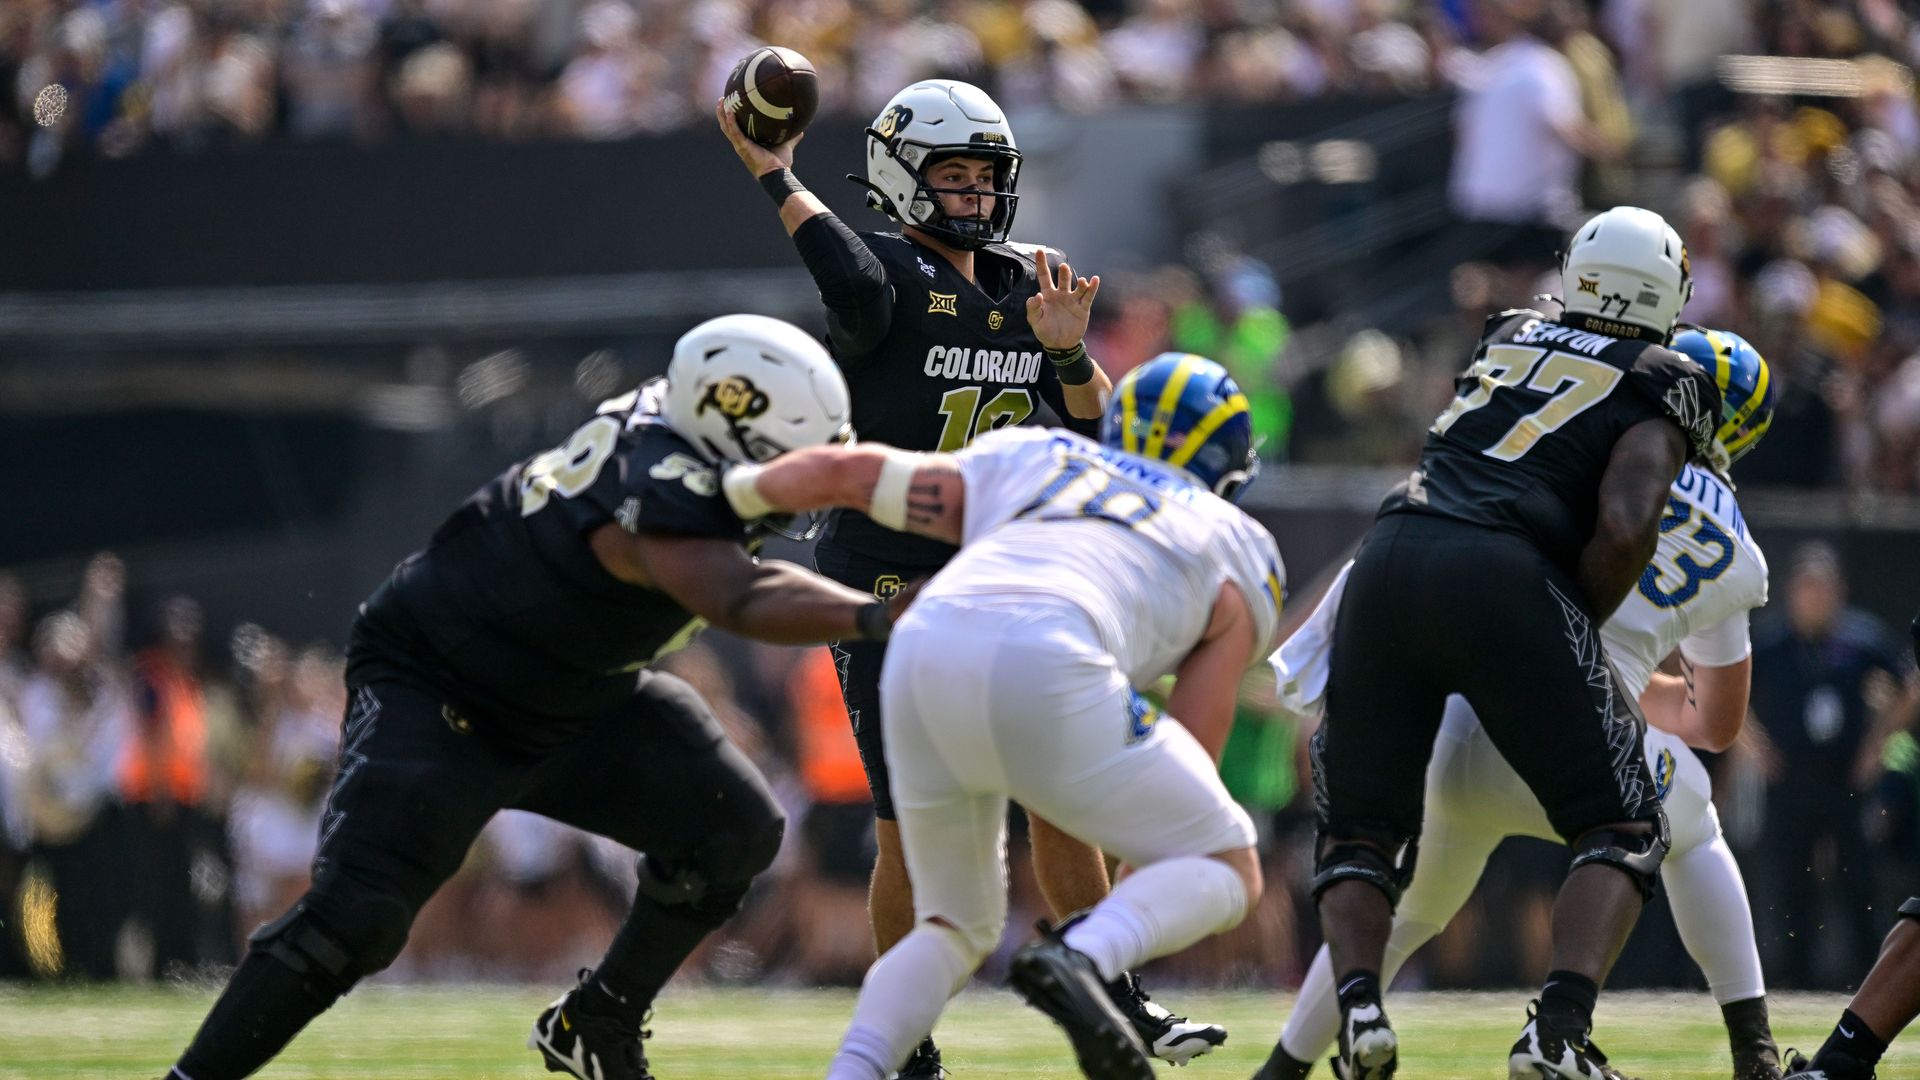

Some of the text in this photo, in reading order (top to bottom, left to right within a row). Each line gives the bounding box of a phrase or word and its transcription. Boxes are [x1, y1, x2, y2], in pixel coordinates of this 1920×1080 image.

[1600, 294, 1632, 319] 77
[1512, 317, 1618, 357] SEATON
[1584, 316, 1642, 339] COLORADO
[923, 345, 1043, 384] COLORADO
[1428, 343, 1626, 464] 77
